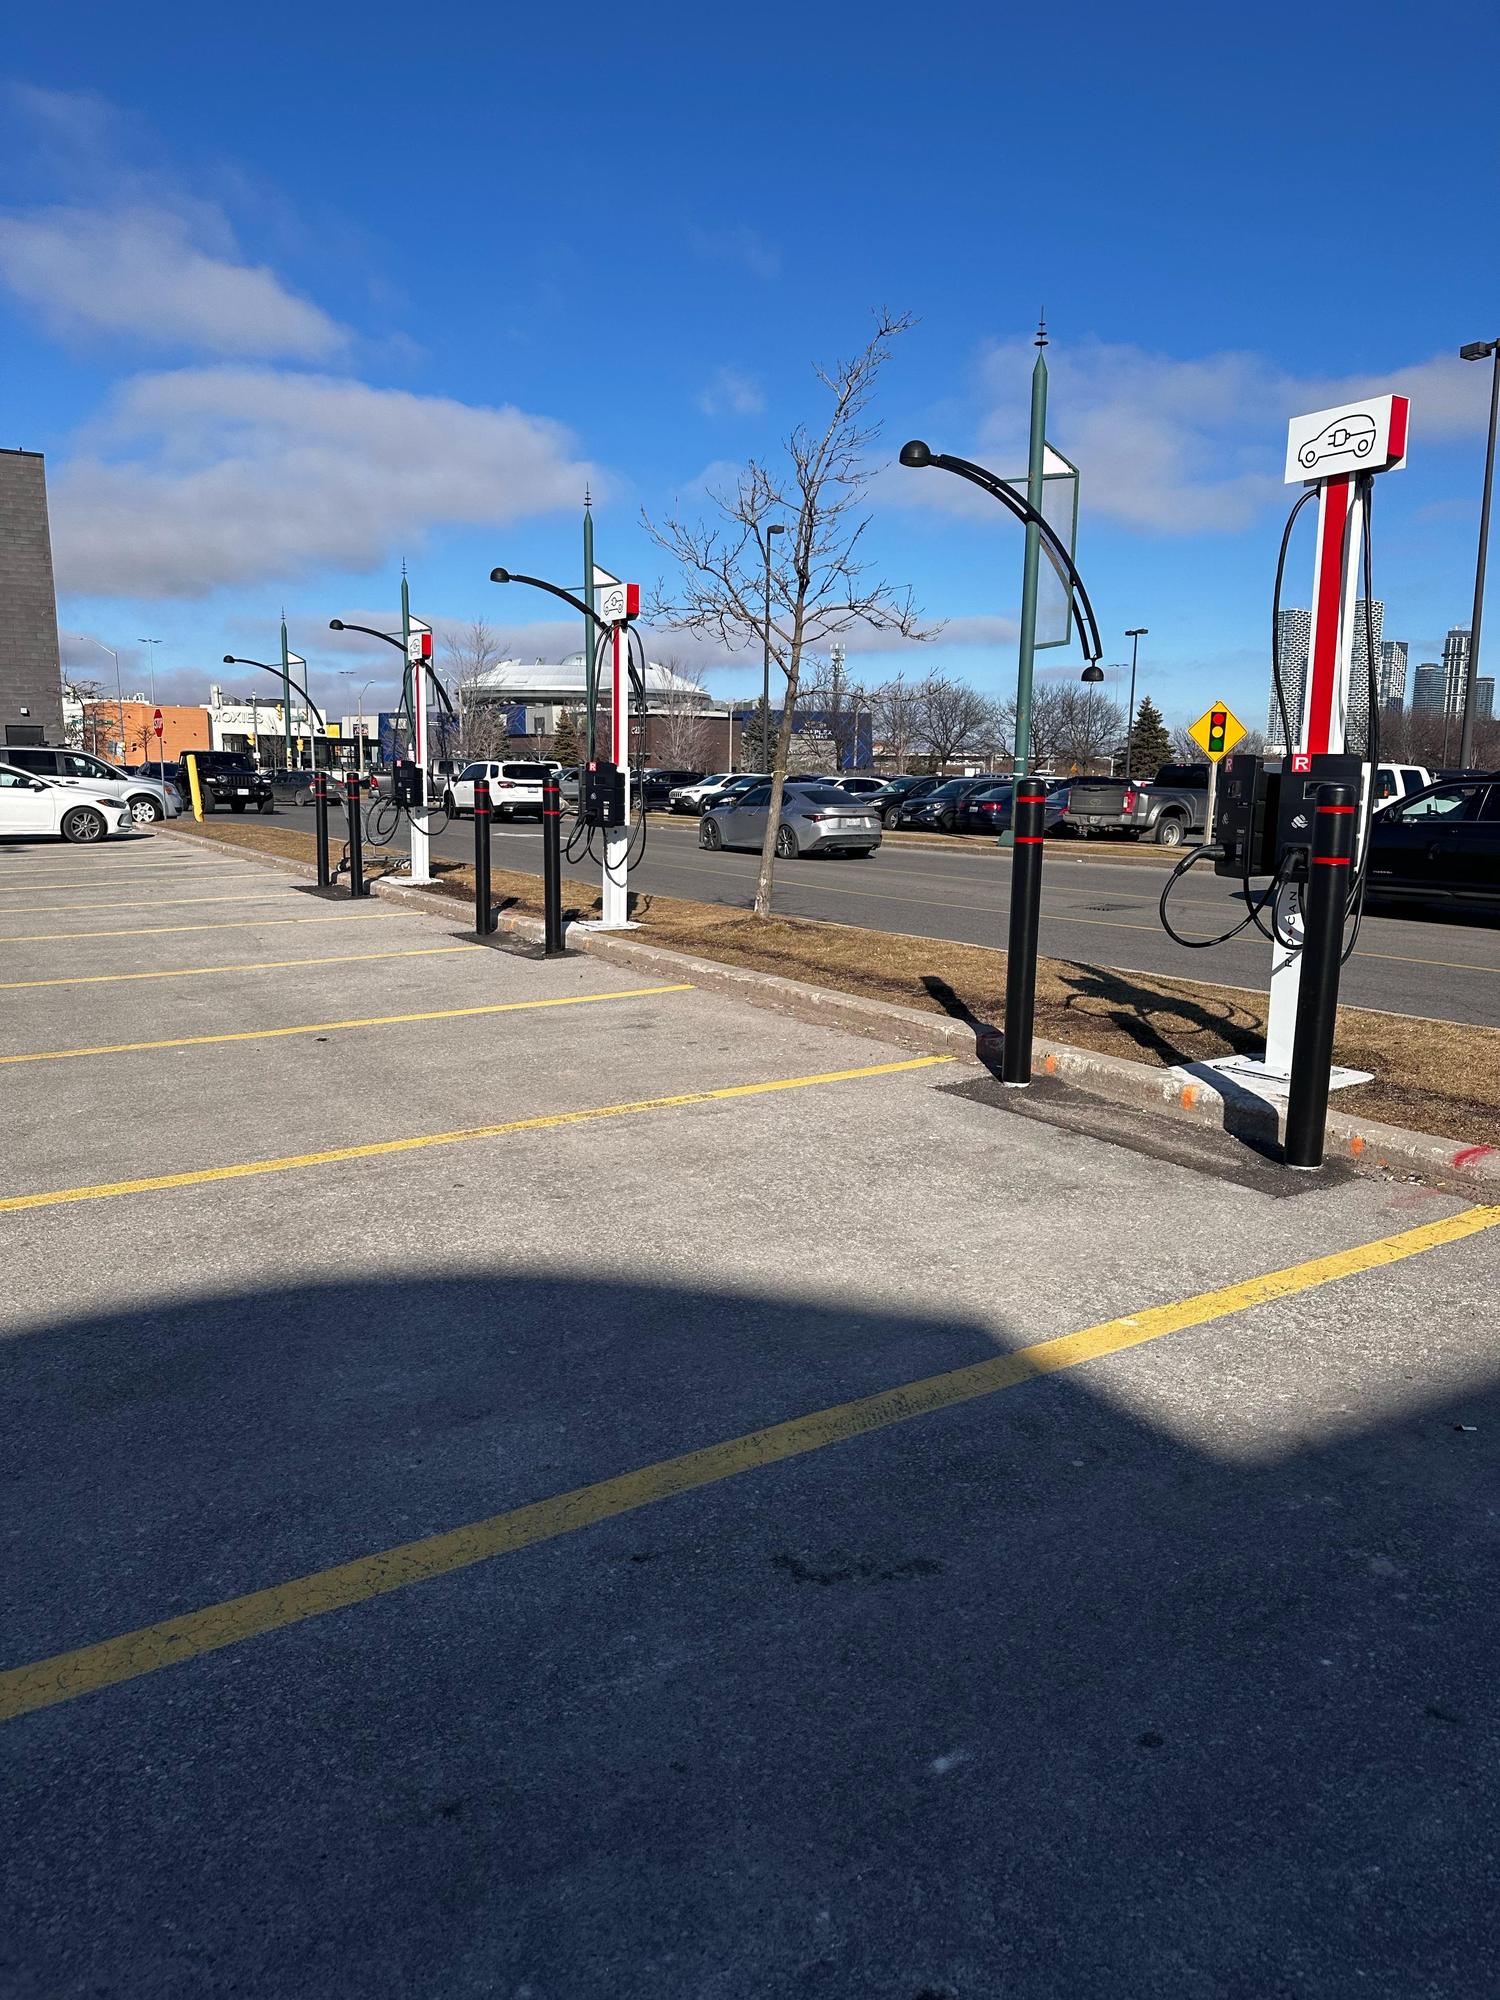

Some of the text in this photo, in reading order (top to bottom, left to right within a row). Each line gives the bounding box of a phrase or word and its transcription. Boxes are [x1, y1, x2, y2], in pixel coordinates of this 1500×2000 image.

[211, 711, 264, 724] MOXIES
[589, 761, 597, 772] R
[1226, 759, 1233, 771] R
[1295, 756, 1309, 770] R
